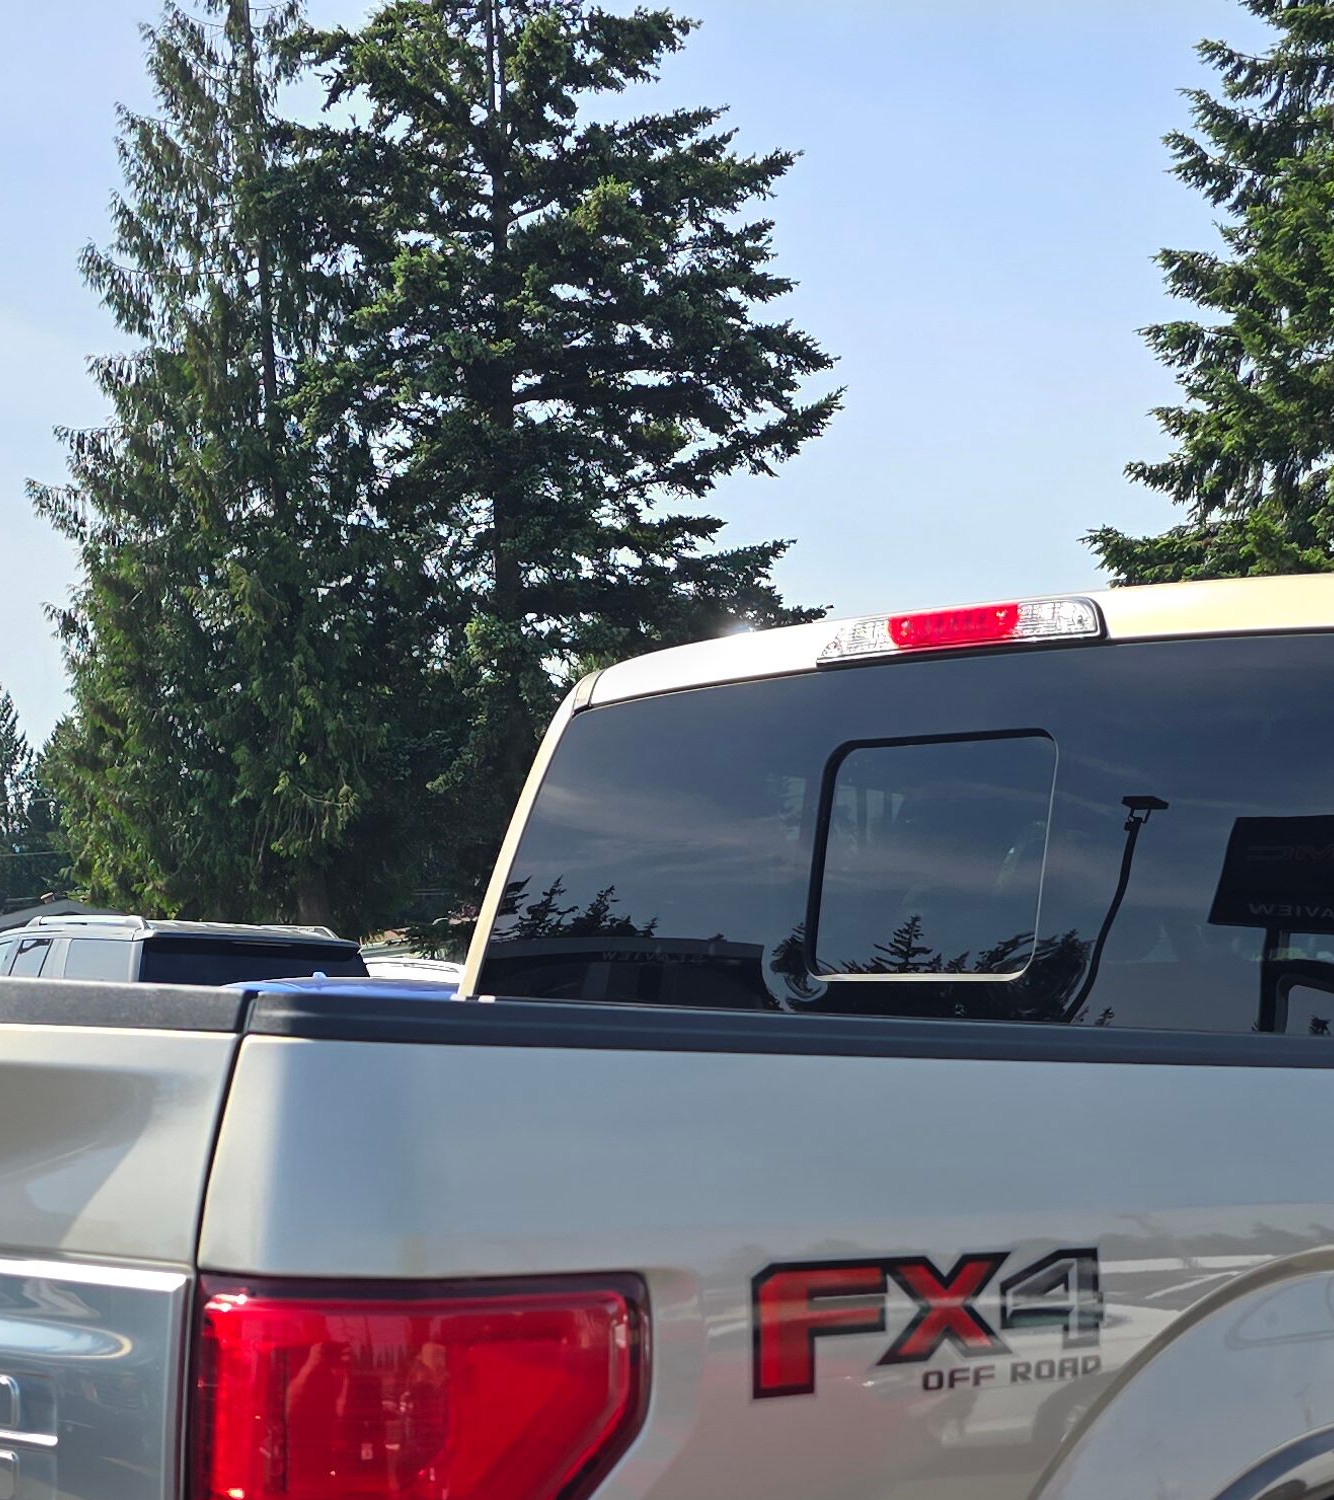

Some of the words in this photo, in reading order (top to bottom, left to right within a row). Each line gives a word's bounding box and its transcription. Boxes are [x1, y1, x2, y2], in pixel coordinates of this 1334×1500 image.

[751, 1247, 1104, 1400] FX4
[921, 1364, 996, 1392] OFF
[1010, 1355, 1102, 1384] ROAD
